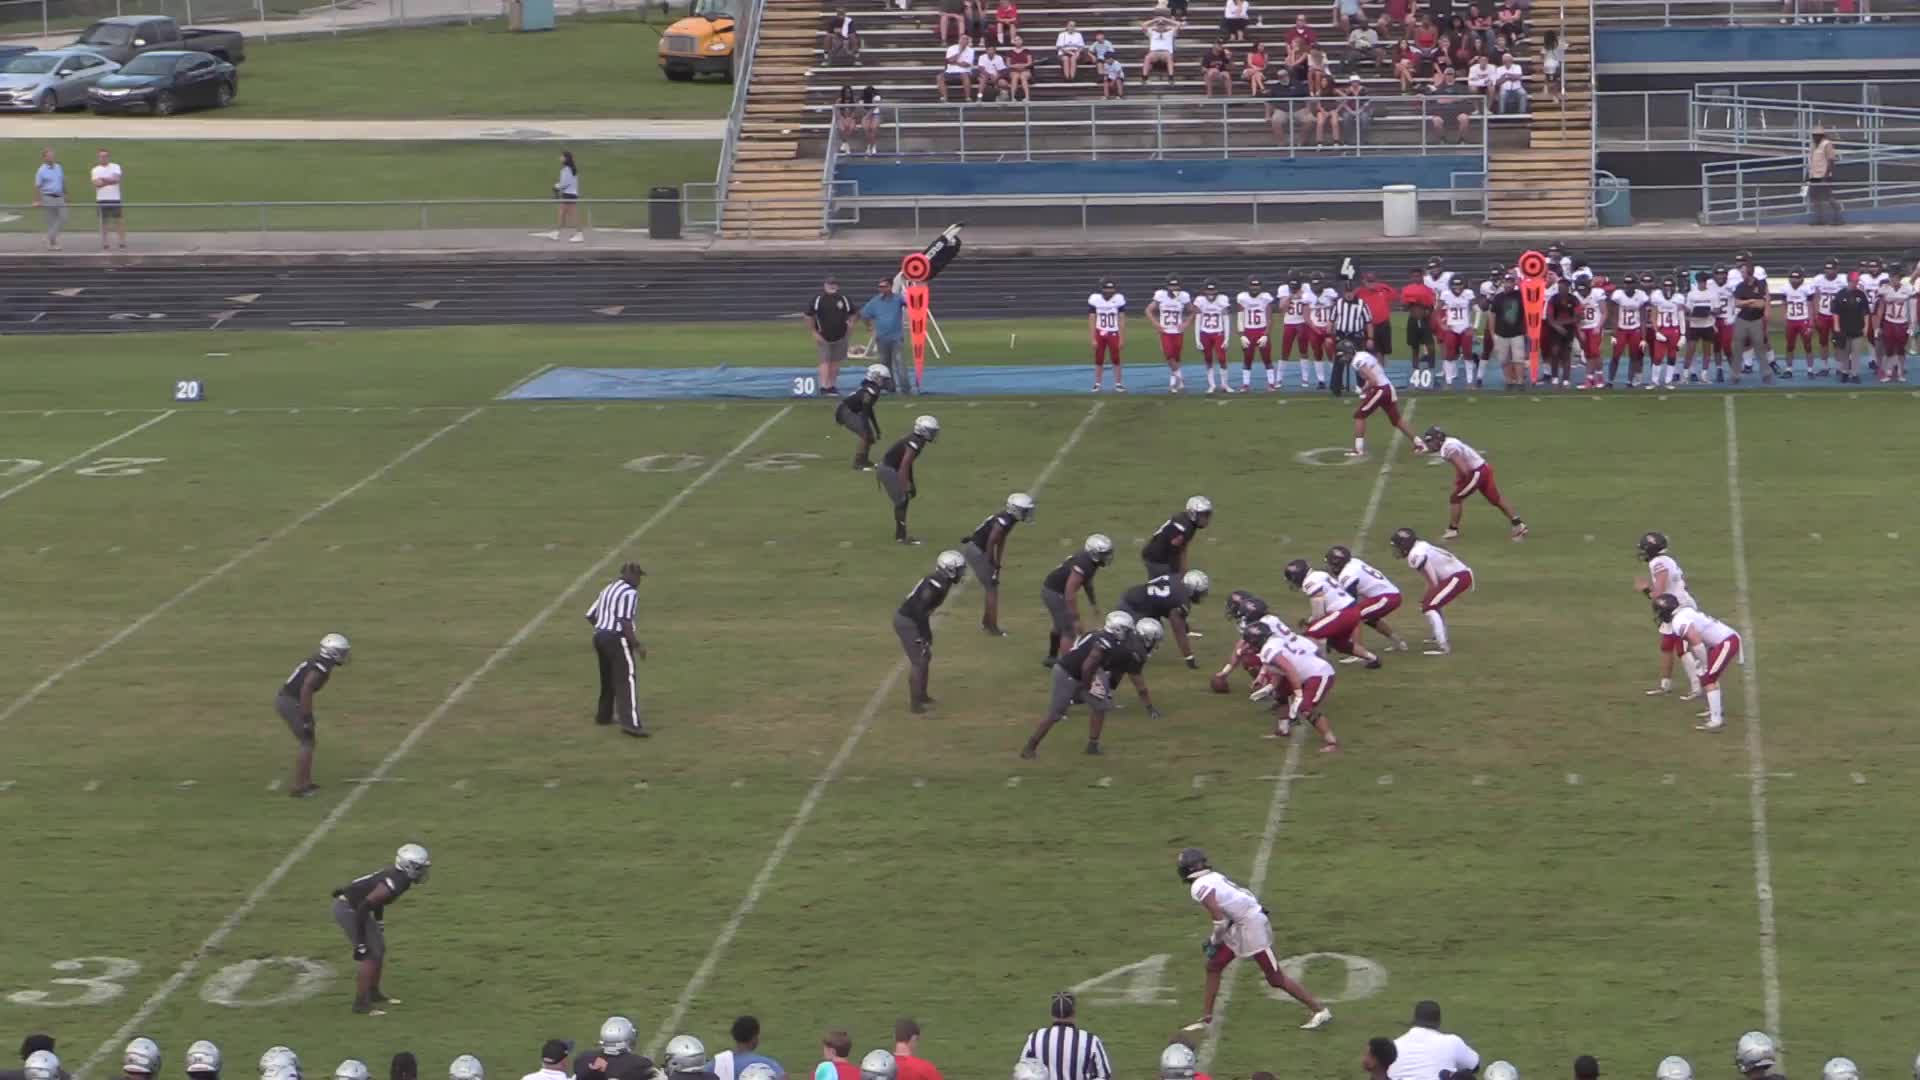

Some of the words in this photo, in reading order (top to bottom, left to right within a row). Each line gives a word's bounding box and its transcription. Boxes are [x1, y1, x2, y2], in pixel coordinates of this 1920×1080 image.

[1340, 256, 1356, 279] 4
[1100, 312, 1116, 328] 80
[1247, 308, 1262, 325] 16
[1622, 308, 1636, 325] 12
[793, 377, 815, 395] 30
[1409, 369, 1431, 388] 40
[176, 381, 198, 399] 20
[7, 956, 338, 1007] 30
